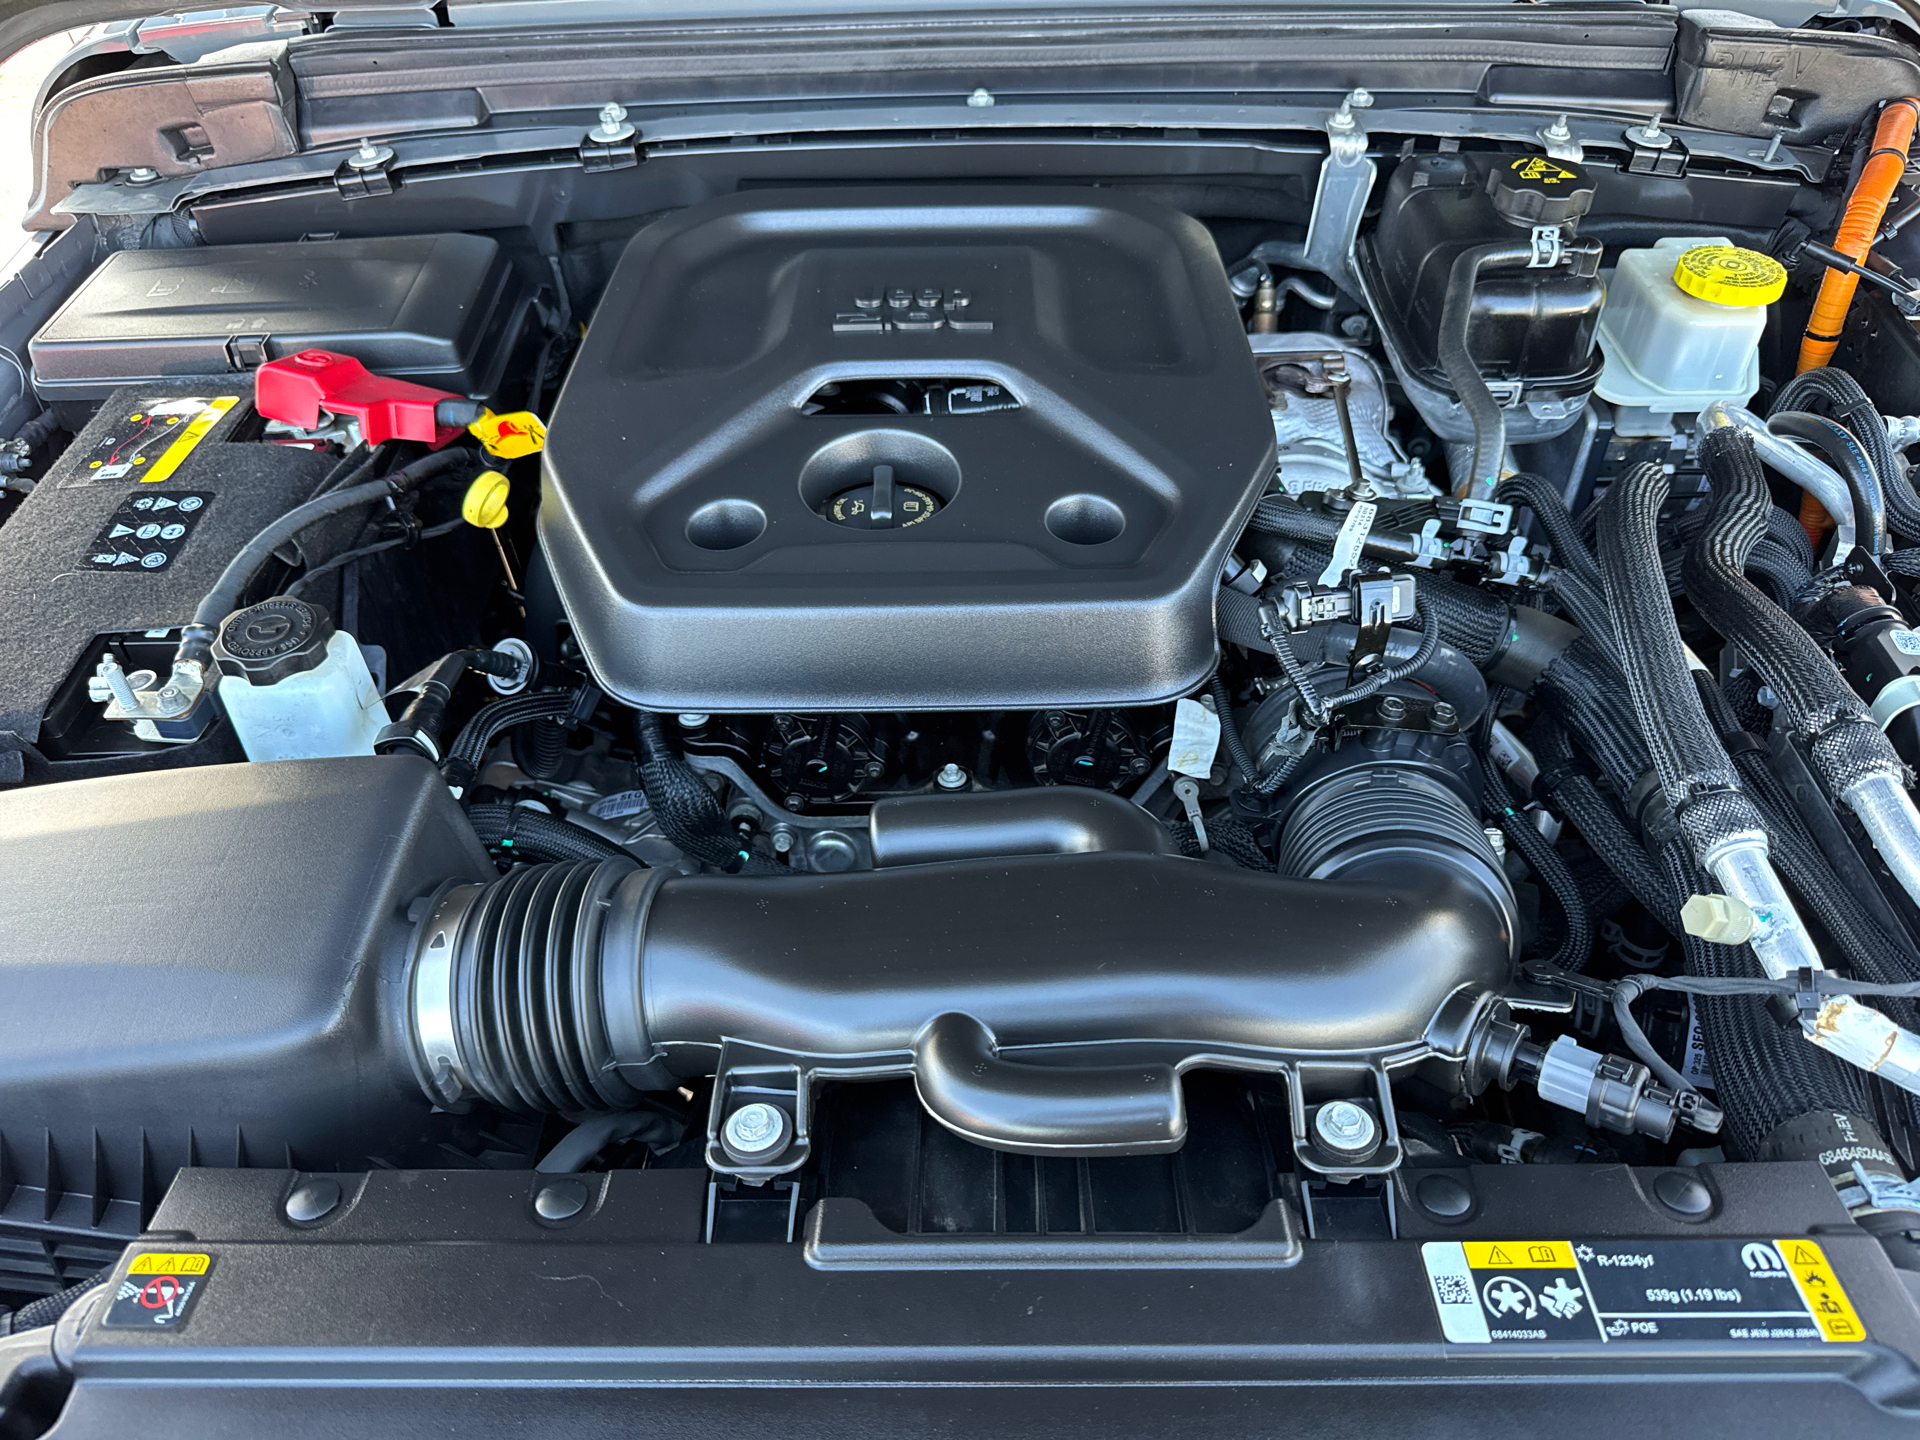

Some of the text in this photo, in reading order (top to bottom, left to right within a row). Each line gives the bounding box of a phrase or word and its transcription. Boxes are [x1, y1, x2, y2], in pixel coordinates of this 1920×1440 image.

[853, 284, 971, 311] Jeep
[247, 601, 298, 615] STEERING
[226, 612, 248, 632] FLUID
[227, 641, 278, 656] APPROVED
[1597, 1254, 1655, 1269] R-1234yf
[1646, 1288, 1742, 1304] 539g (1.19 lbs)
[1491, 1329, 1547, 1340] 68414033AB
[1631, 1322, 1659, 1334] POE
